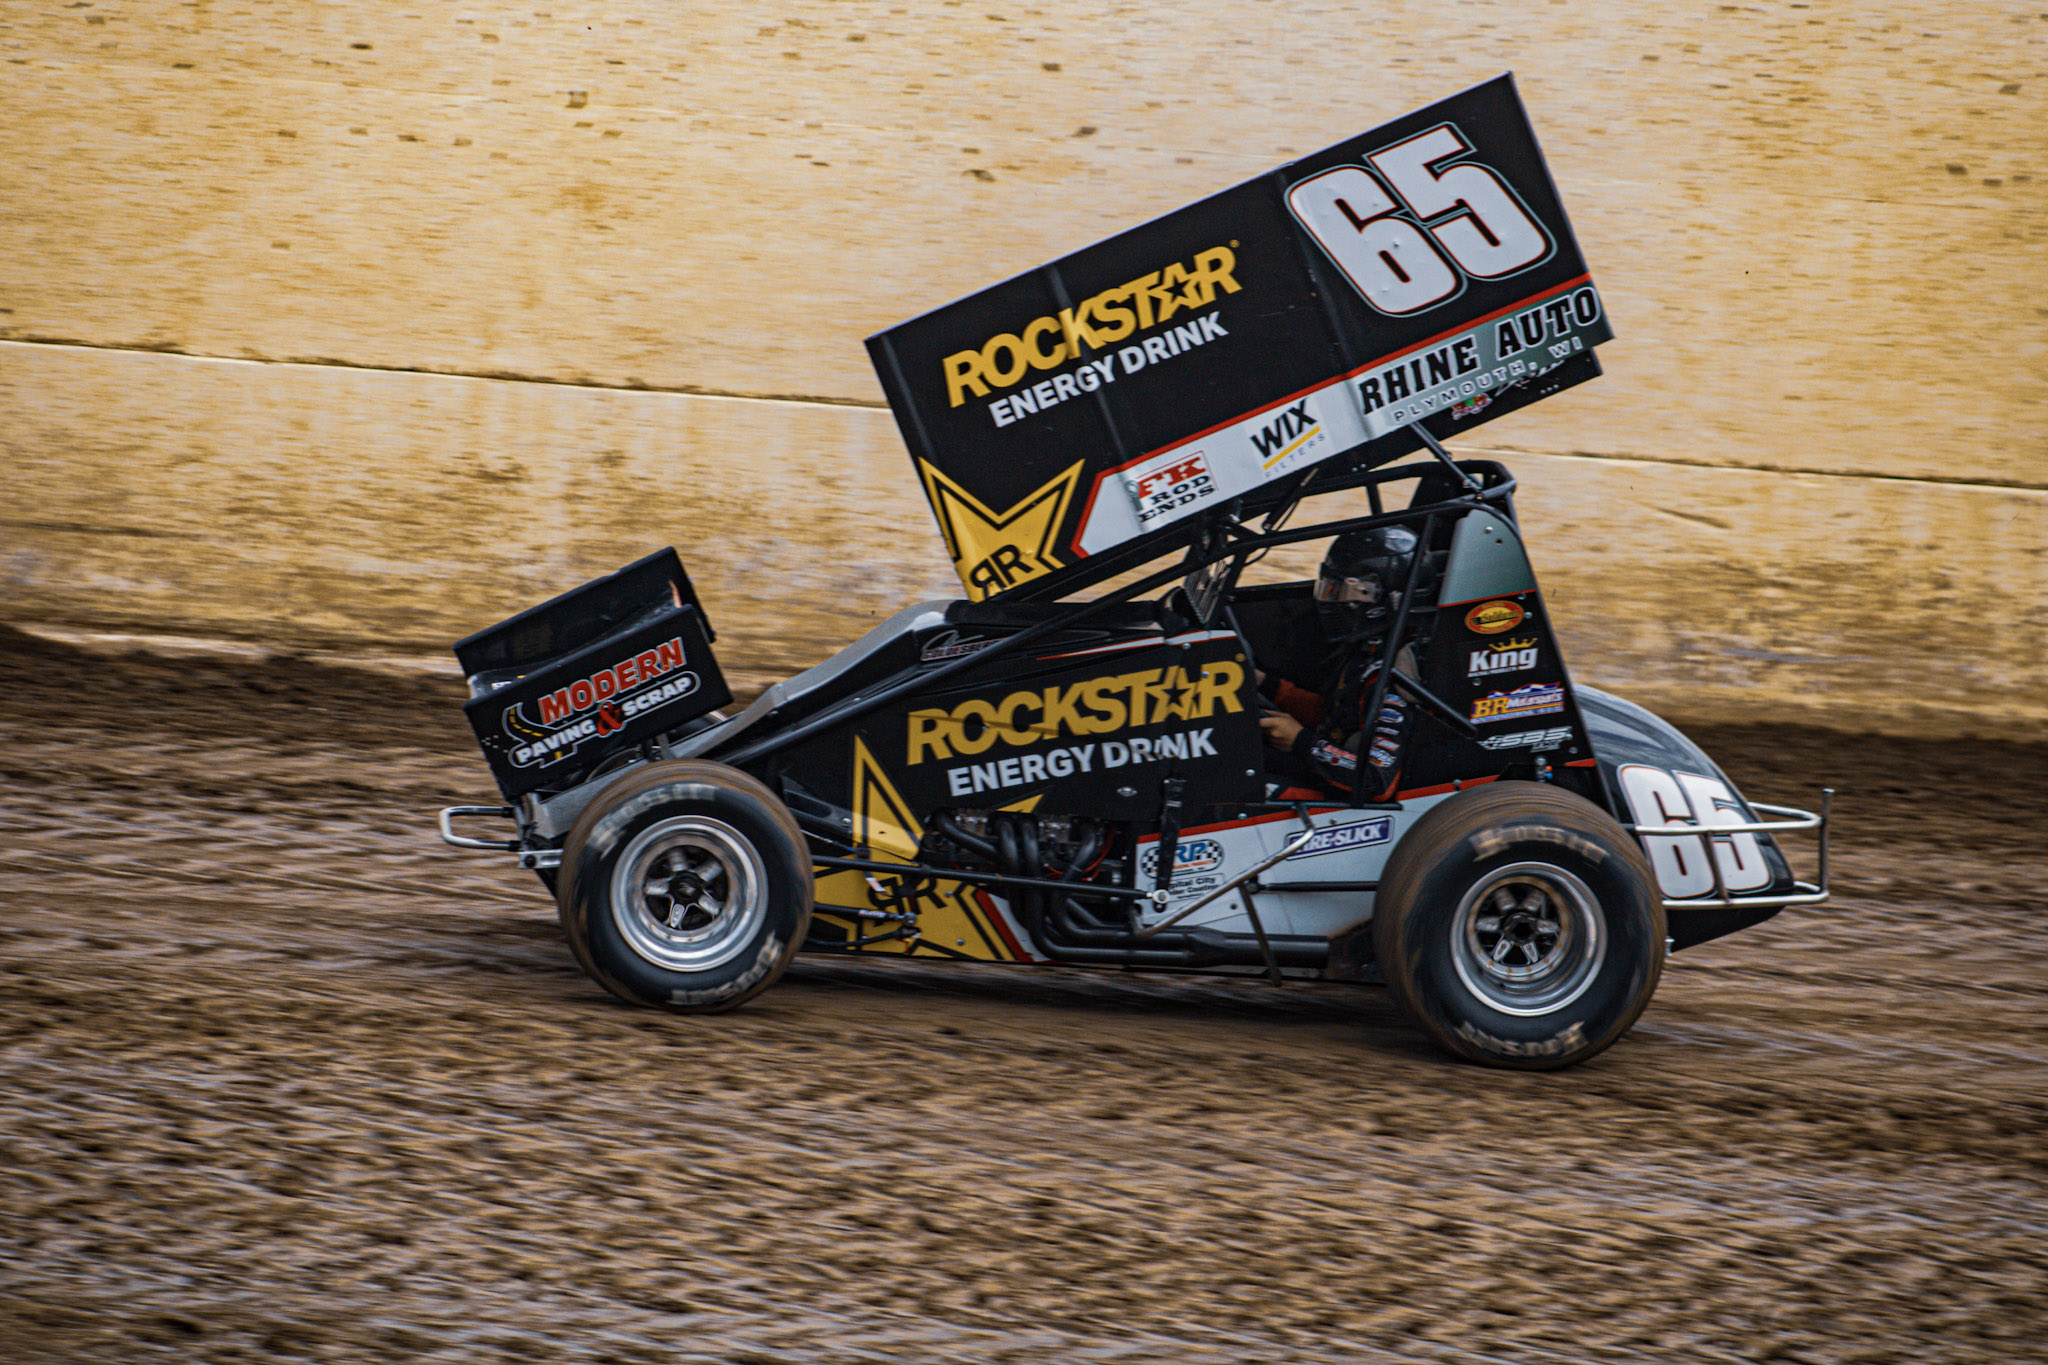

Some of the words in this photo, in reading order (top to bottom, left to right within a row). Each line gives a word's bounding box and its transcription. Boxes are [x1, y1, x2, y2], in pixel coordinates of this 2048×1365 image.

[1285, 122, 1557, 317] 65
[942, 245, 1243, 408] ROCKSTAR
[1357, 334, 1481, 415] RHINE
[1495, 287, 1600, 361] AUTO
[1547, 336, 1583, 359] WI
[988, 354, 1115, 428] ENERGY
[1118, 311, 1229, 375] DRINK
[1250, 397, 1318, 458] WIX
[1265, 433, 1326, 477] FILTERS
[1137, 456, 1207, 499] FK
[1140, 486, 1216, 523] ENDS
[1151, 475, 1210, 506] ROD
[537, 636, 687, 726] MODERN
[1469, 648, 1539, 673] King
[516, 719, 597, 764] PAVING
[596, 699, 625, 738] &
[621, 676, 693, 718] SCRAP
[907, 660, 1245, 766] ROCKSTAR
[1473, 696, 1509, 718] BR
[947, 744, 1096, 797] ENERGY
[1617, 763, 1775, 900] 65
